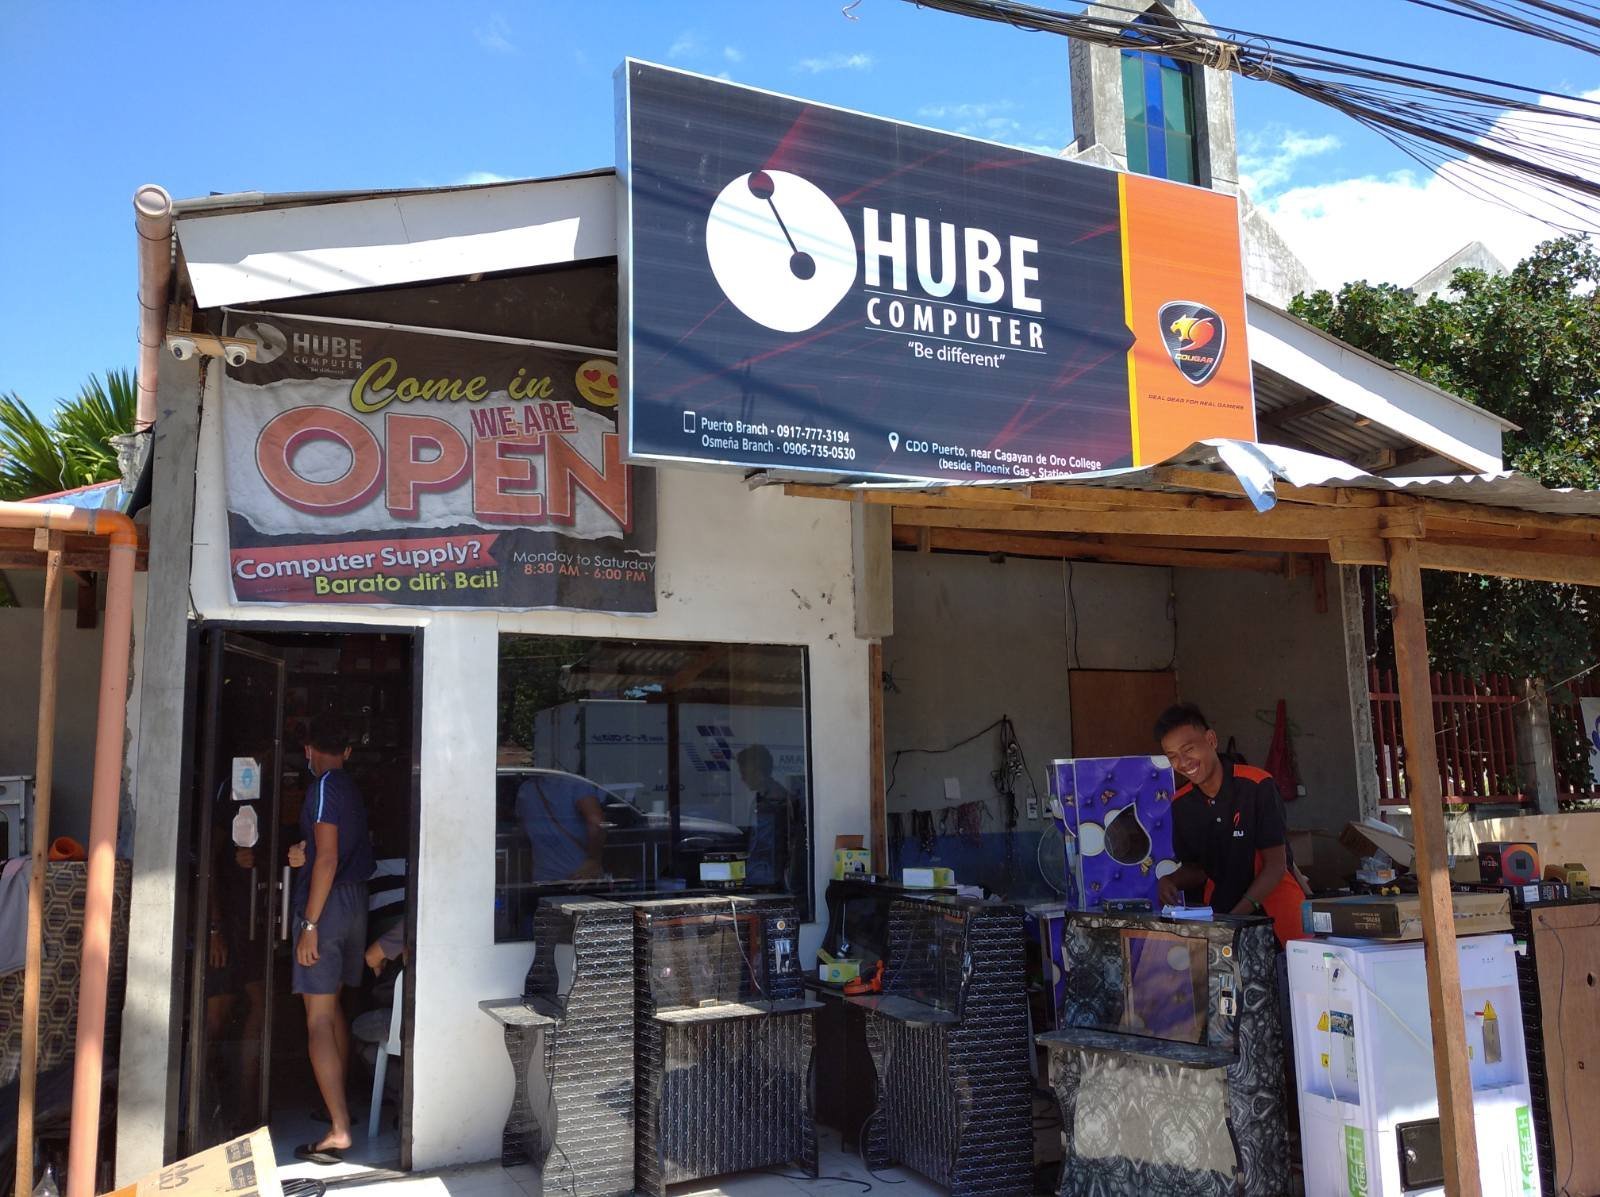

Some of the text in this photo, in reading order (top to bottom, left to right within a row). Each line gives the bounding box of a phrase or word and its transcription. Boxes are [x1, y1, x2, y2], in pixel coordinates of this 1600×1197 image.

[863, 207, 1042, 313] HUBE
[866, 297, 1044, 349] COMPUTER
[293, 332, 362, 360] HUBE
[908, 341, 1005, 368] “Be different”
[1174, 353, 1214, 364] COUGAR
[294, 356, 363, 369] COMPUTER
[350, 357, 554, 414] Come in
[470, 401, 577, 440] WE ARE
[701, 417, 733, 433] Puerto
[736, 420, 768, 436] Branch
[777, 424, 850, 444] 0917-777-3194
[701, 434, 739, 450] Osmeña
[742, 440, 774, 453] Branch
[783, 441, 856, 461] 0906-735-0530
[905, 439, 1102, 471] CDO Puerto, near Cagayan de Oro College
[254, 404, 631, 531] OPEN
[938, 458, 972, 471] (beside
[974, 463, 1010, 476] Phoenix
[236, 540, 481, 579] Computer Supply?
[513, 551, 656, 573] Monday to Saturday
[524, 563, 554, 575] 8:30
[558, 565, 580, 577] AM
[594, 568, 621, 580] 6:00
[625, 571, 647, 582] PM
[315, 570, 499, 594] Barato diri Bai!
